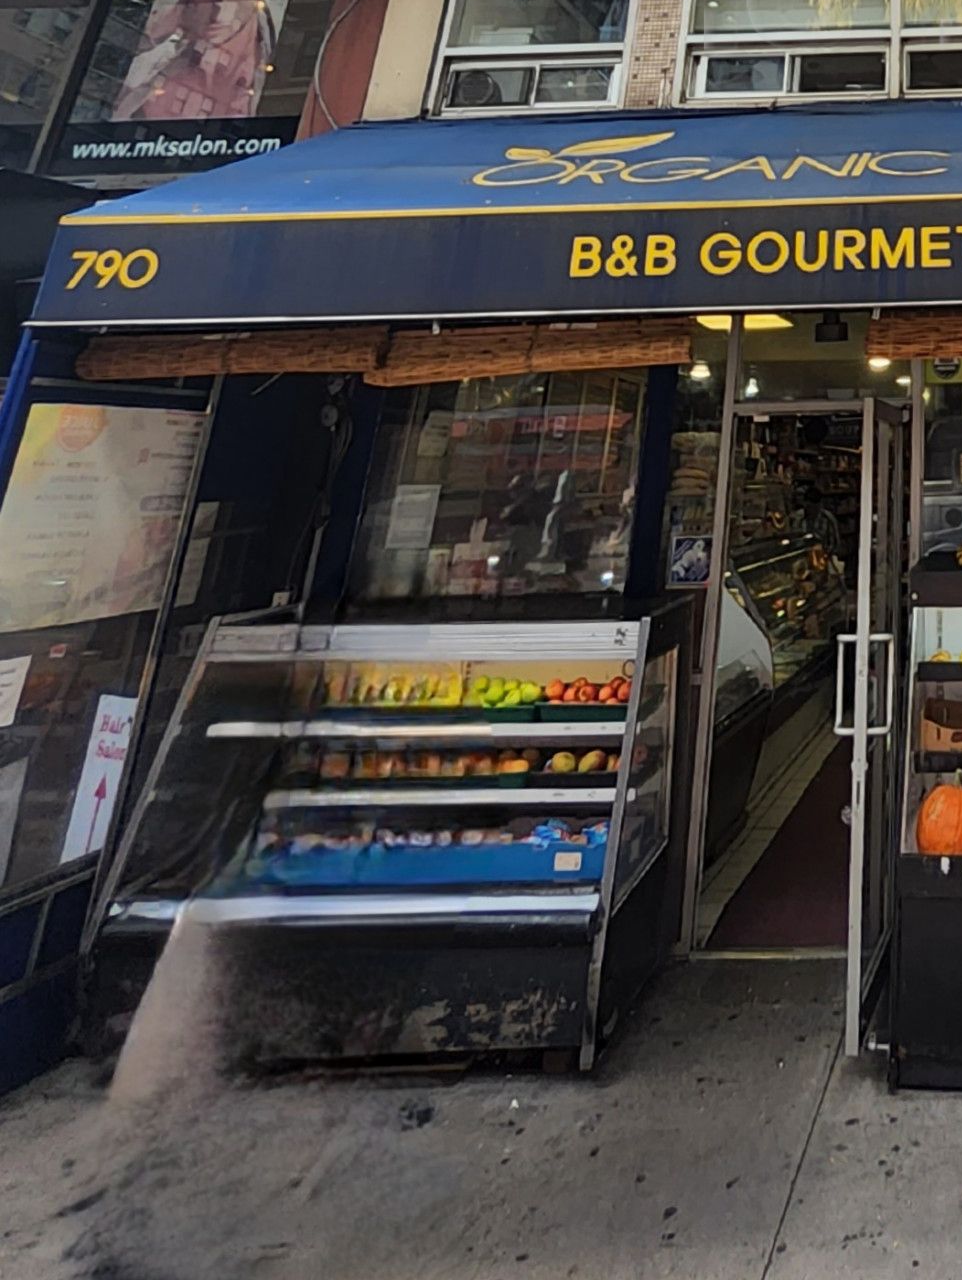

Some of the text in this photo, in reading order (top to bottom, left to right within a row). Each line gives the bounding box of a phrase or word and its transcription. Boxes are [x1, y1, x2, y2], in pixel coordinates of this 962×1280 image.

[72, 134, 281, 160] www.mksalon.com
[470, 149, 953, 187] ORGANIC
[64, 247, 159, 291] 790
[568, 234, 677, 279] B&B
